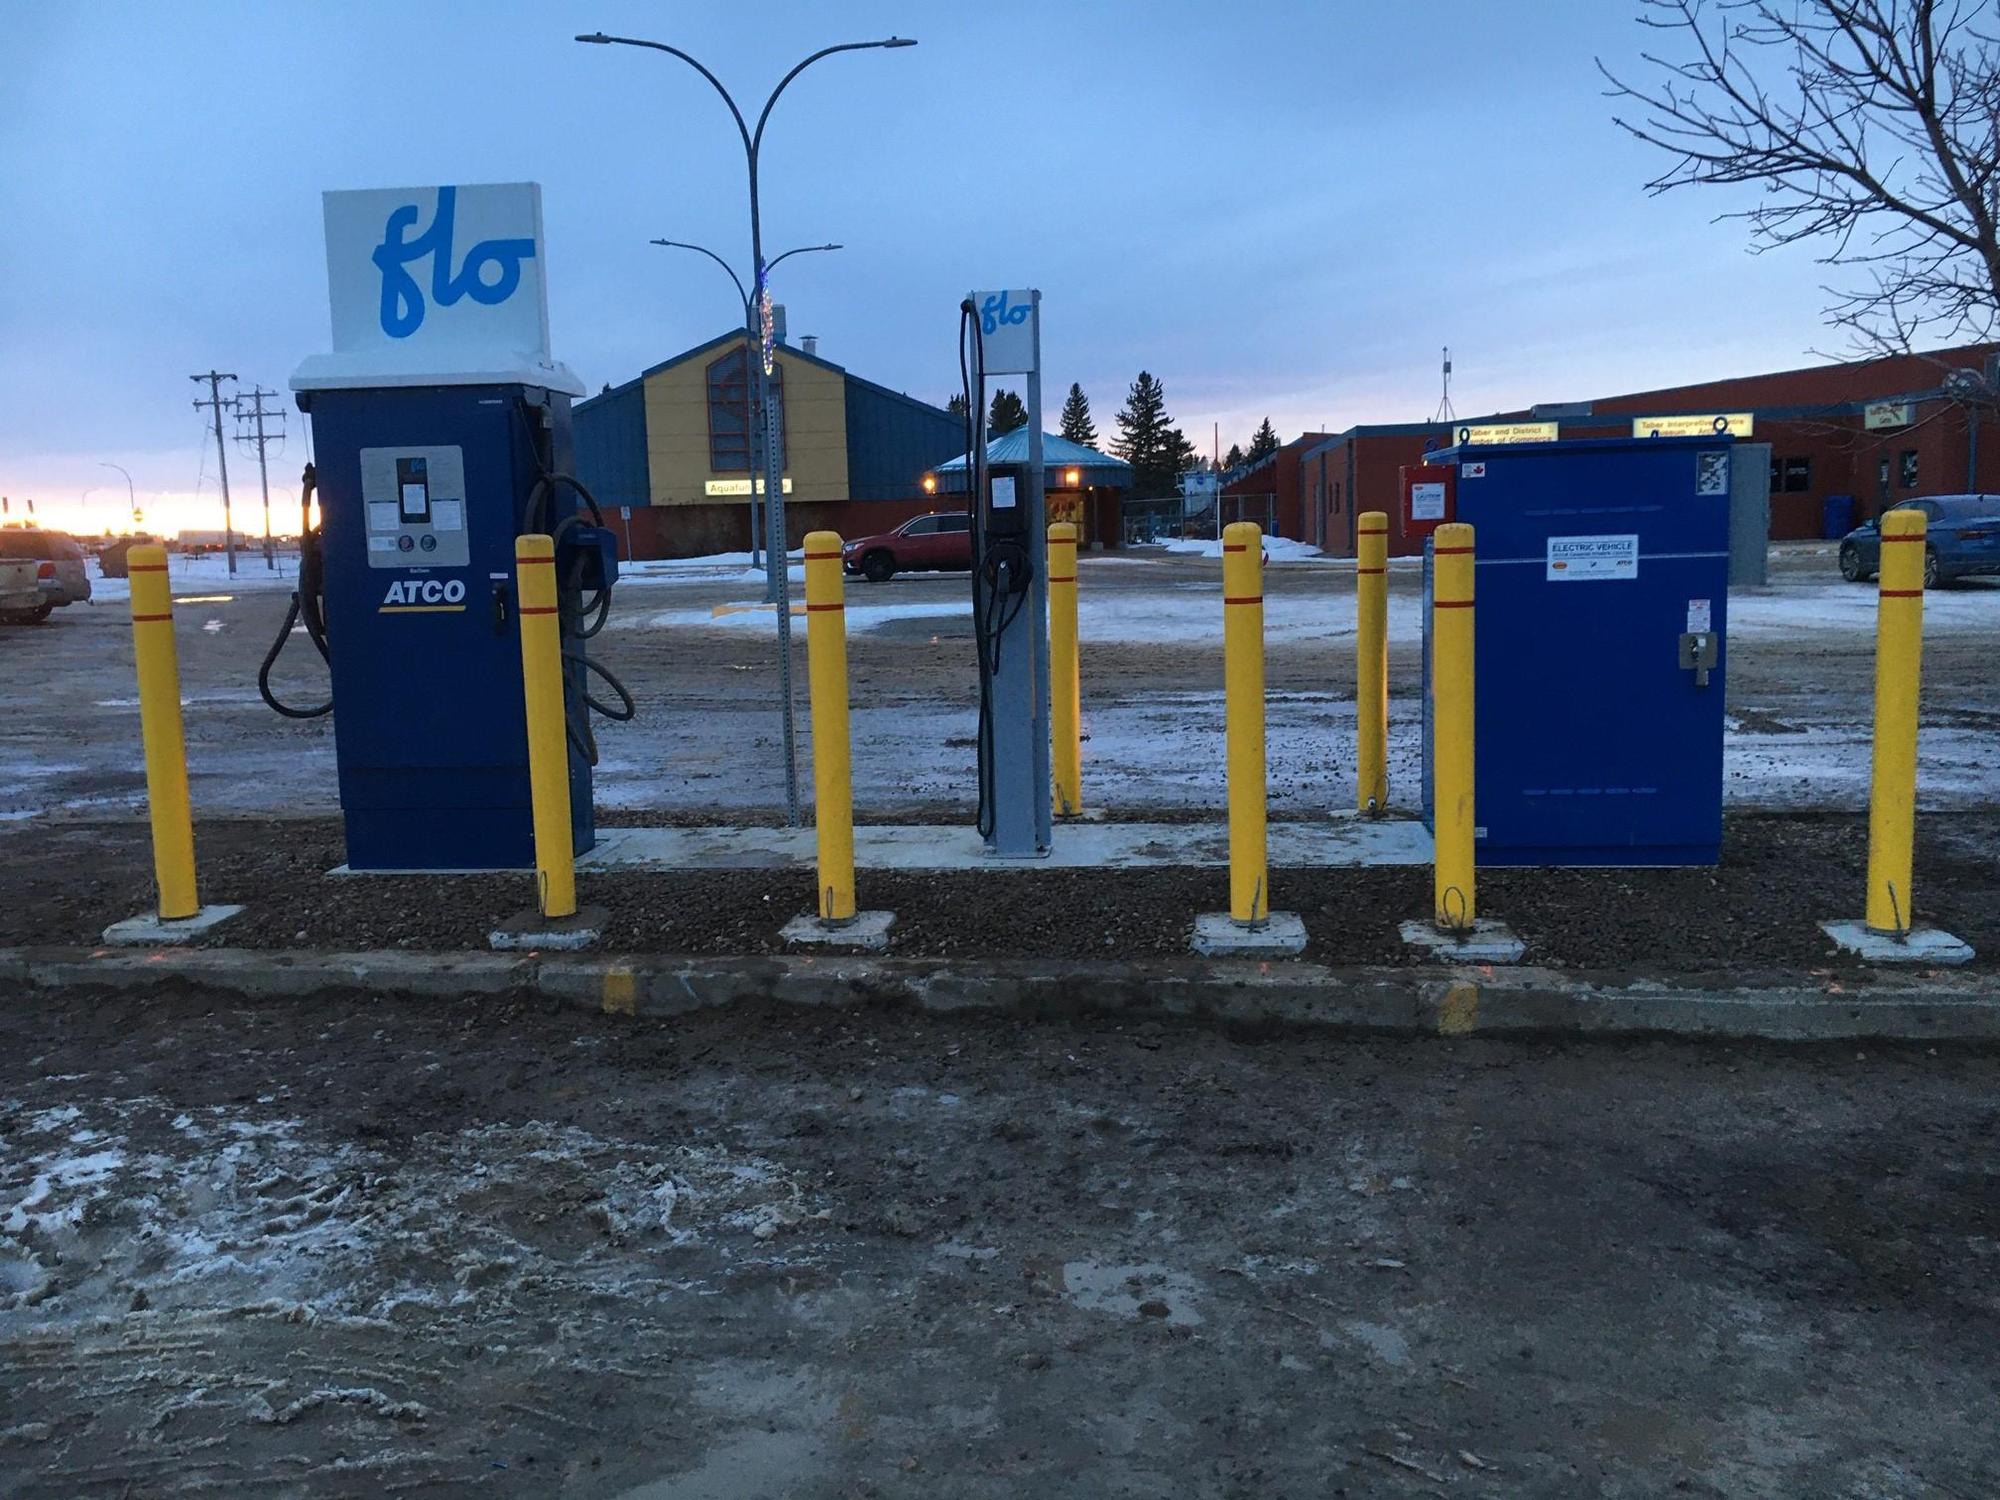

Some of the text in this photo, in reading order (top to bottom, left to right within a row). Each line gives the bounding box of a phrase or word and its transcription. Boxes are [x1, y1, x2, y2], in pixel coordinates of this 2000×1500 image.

[372, 185, 536, 338] flo
[981, 290, 1032, 335] flo
[1495, 427, 1510, 435] and
[1513, 427, 1542, 435] District
[710, 484, 751, 493] Aquafun
[1553, 542, 1633, 552] ELECTRIC VEHICLE
[383, 580, 466, 604] ATCO
